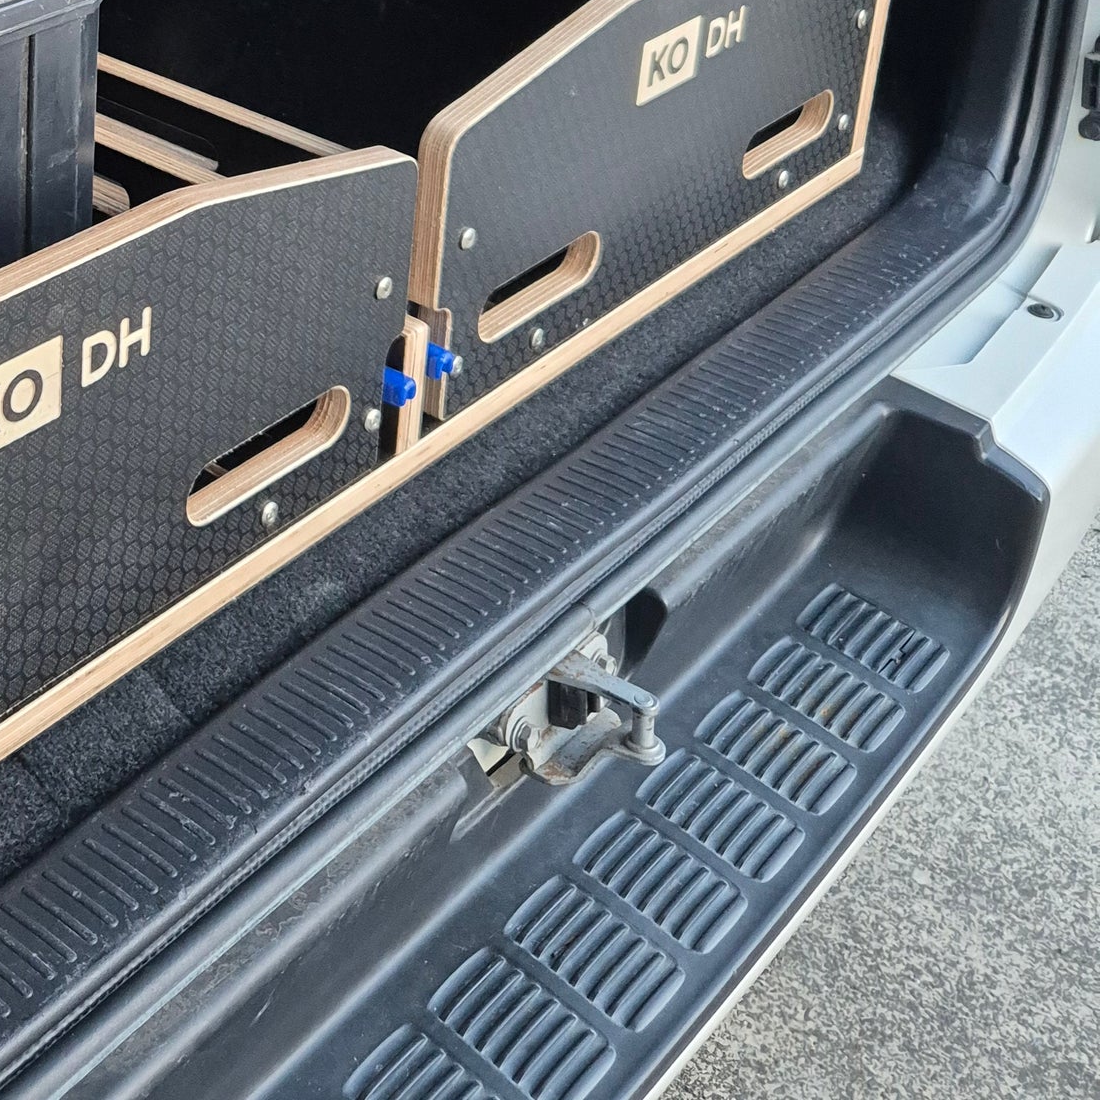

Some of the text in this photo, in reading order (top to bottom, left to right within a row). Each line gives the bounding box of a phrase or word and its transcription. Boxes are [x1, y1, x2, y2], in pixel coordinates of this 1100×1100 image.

[646, 4, 748, 88] KO DH
[80, 306, 152, 388] DH
